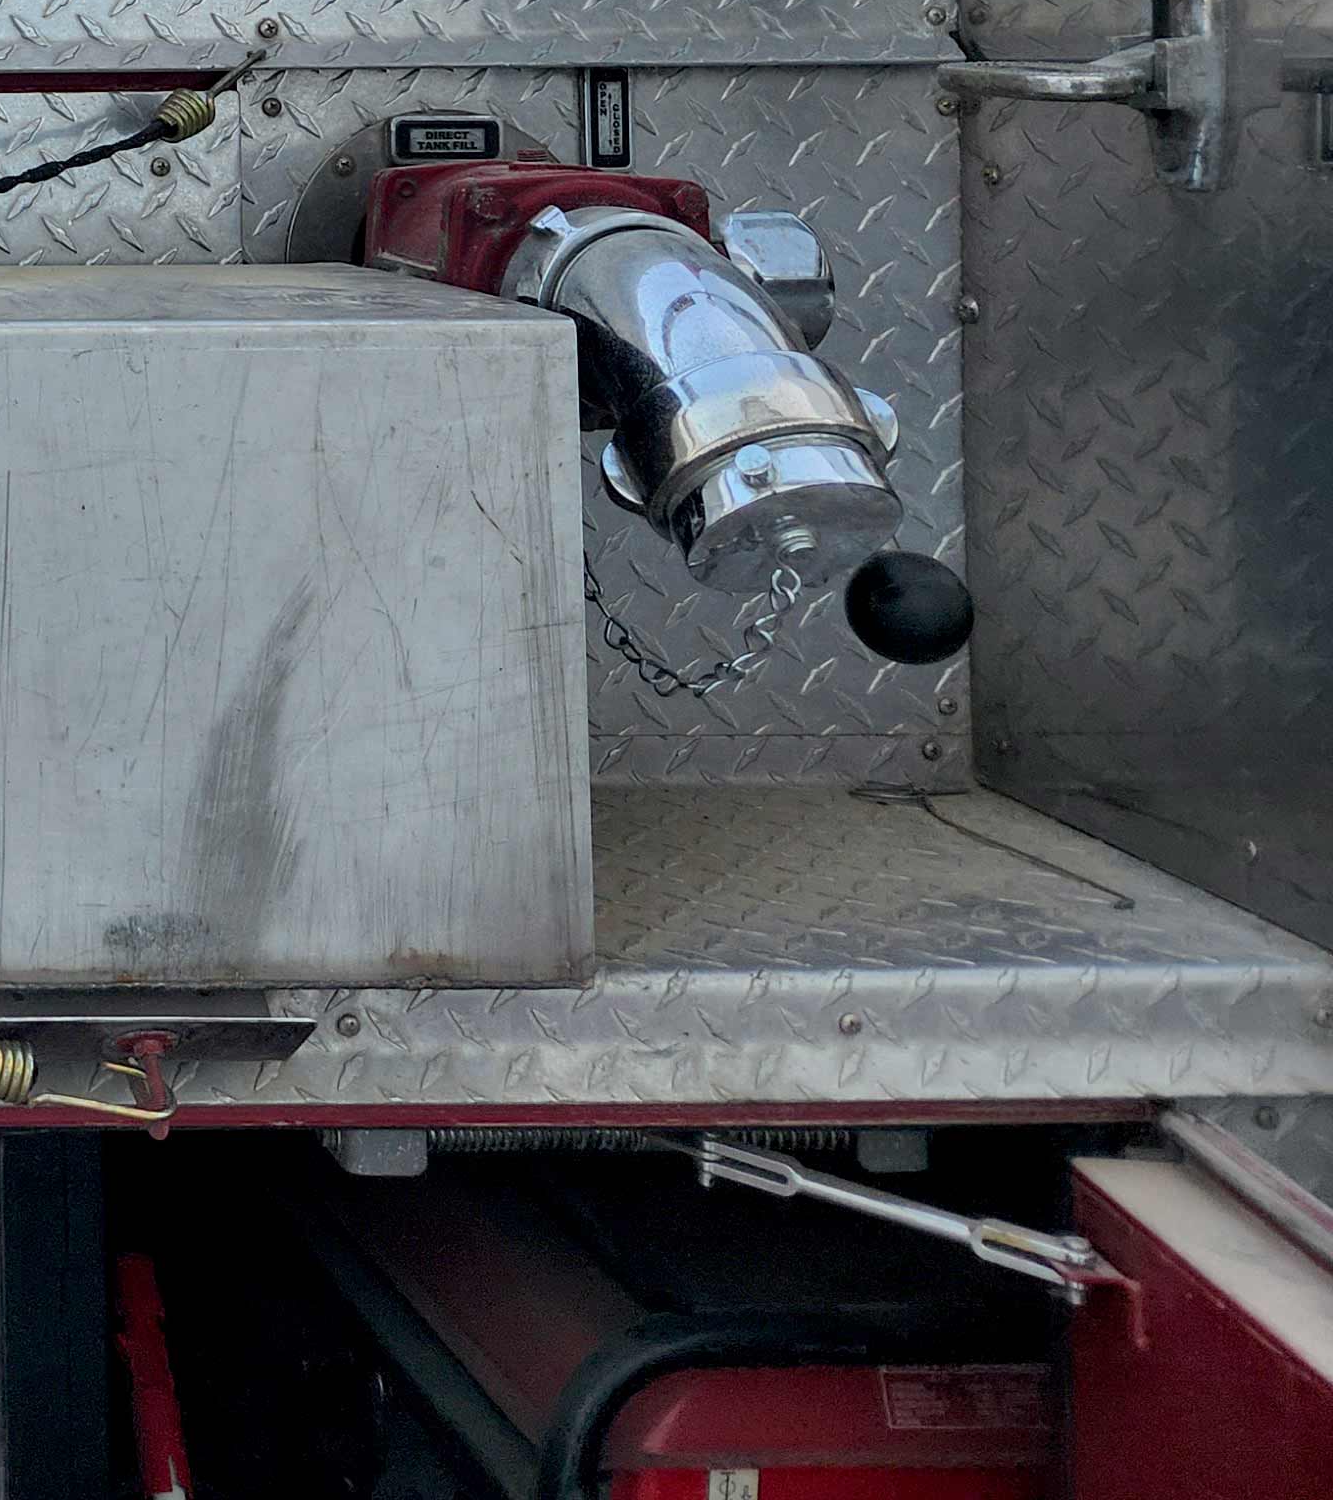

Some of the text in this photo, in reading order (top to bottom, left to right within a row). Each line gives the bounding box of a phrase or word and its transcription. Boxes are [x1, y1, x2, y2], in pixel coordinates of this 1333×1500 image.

[599, 82, 607, 117] OPEN
[425, 131, 470, 140] DIRECT
[613, 104, 621, 153] CLOSED
[417, 140, 478, 150] TANK FILL
